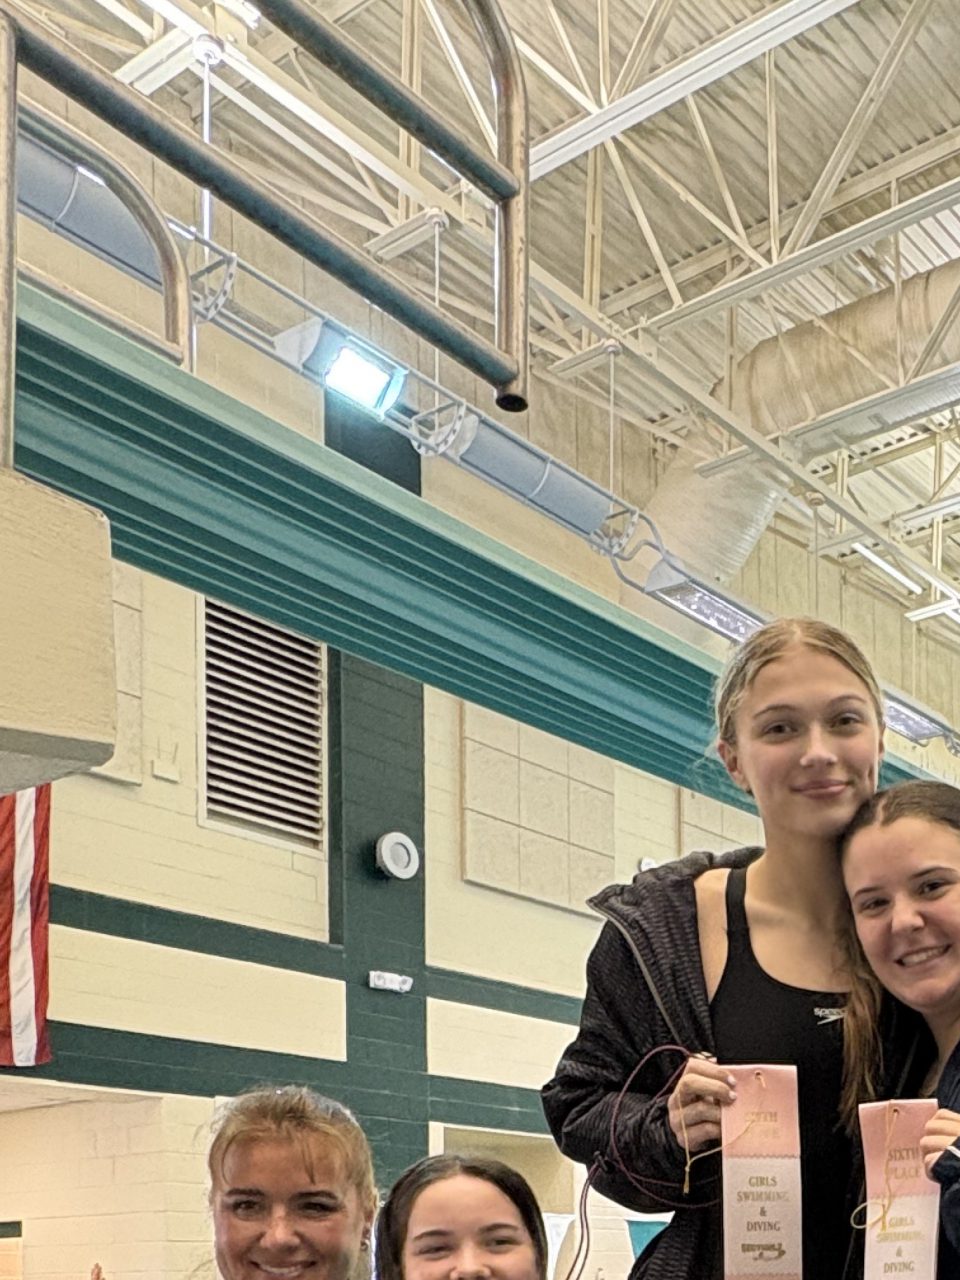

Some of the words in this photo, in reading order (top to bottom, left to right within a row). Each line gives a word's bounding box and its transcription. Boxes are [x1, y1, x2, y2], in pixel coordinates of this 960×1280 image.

[748, 1176, 778, 1187] GIRLS
[737, 1190, 790, 1202] SWIMMING
[759, 1206, 768, 1217] &
[746, 1220, 782, 1233] DIVING
[883, 1261, 915, 1274] DIVING
